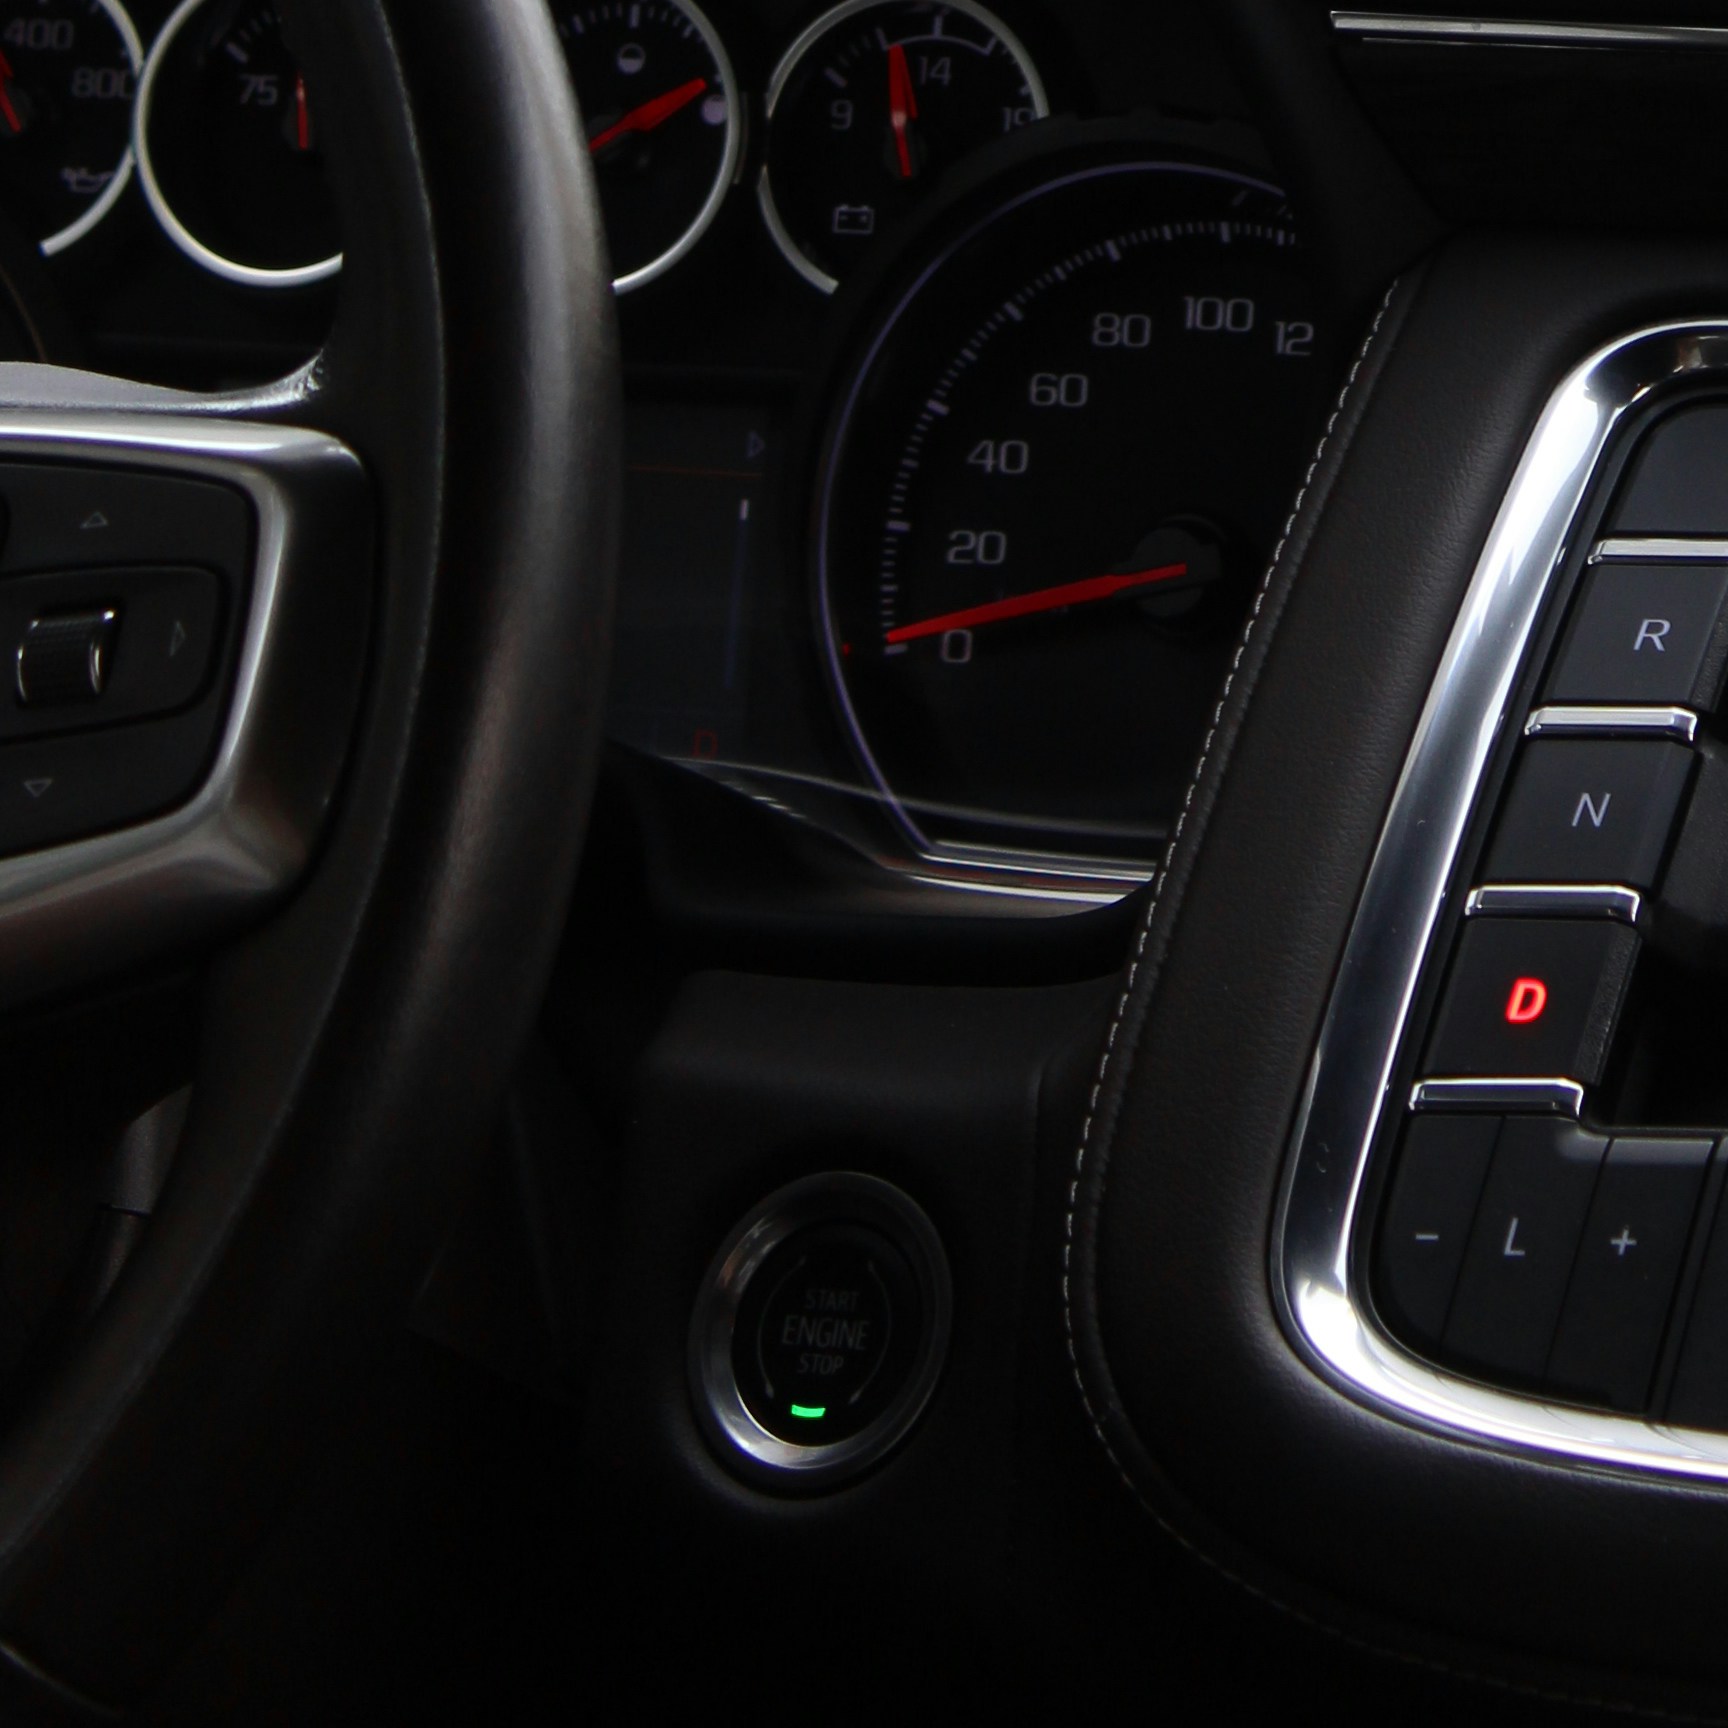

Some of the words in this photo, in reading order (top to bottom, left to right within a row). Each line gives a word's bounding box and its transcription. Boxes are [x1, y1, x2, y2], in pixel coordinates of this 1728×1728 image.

[3, 17, 75, 50] 400
[920, 56, 952, 86] 14
[239, 74, 280, 107] 75
[831, 99, 854, 130] 9
[1091, 312, 1152, 348] 80
[1185, 296, 1255, 332] 100
[1029, 372, 1089, 407] 60
[967, 439, 1029, 474] 40
[946, 530, 1007, 565] 20
[940, 628, 973, 664] 0
[1633, 618, 1671, 651] R
[1571, 792, 1611, 827] N
[1504, 976, 1548, 1024] D
[1503, 1217, 1525, 1256] L
[803, 1288, 860, 1312] START
[780, 1313, 872, 1352] ENGINE
[796, 1351, 846, 1376] STOP
